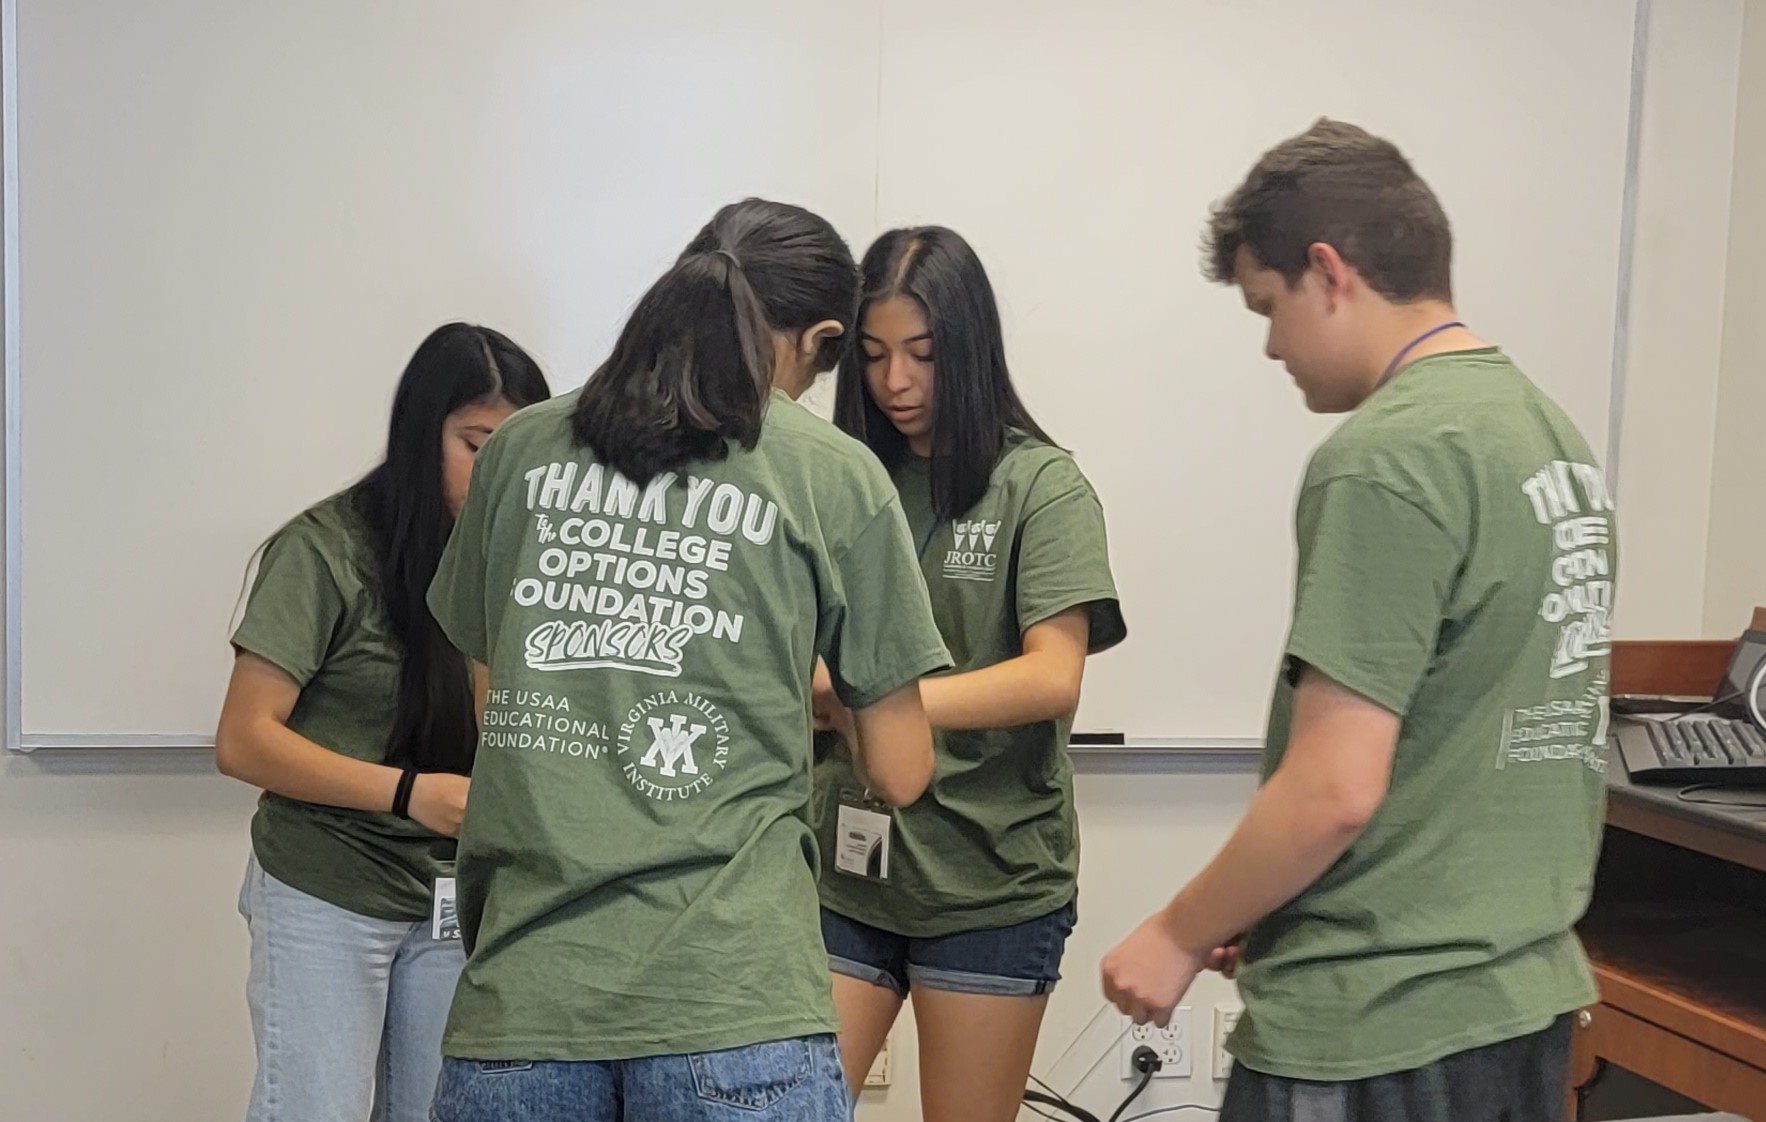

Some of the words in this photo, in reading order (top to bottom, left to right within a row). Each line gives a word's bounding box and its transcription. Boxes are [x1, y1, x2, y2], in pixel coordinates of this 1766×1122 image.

[524, 462, 679, 525] THANK
[681, 475, 778, 546] YOU
[559, 517, 733, 571] COLLEGE
[943, 550, 997, 567] JROTC
[538, 547, 710, 599] OPTIONS
[509, 577, 744, 643] OUNDATION
[524, 619, 694, 663] SPONSORS
[486, 689, 510, 705] THE
[516, 690, 570, 712] USAA
[483, 711, 610, 740] EDUCATIONAL
[616, 690, 679, 755] VIRGINIA
[683, 692, 730, 770] MILITARY
[622, 762, 714, 801] INSTITUTE
